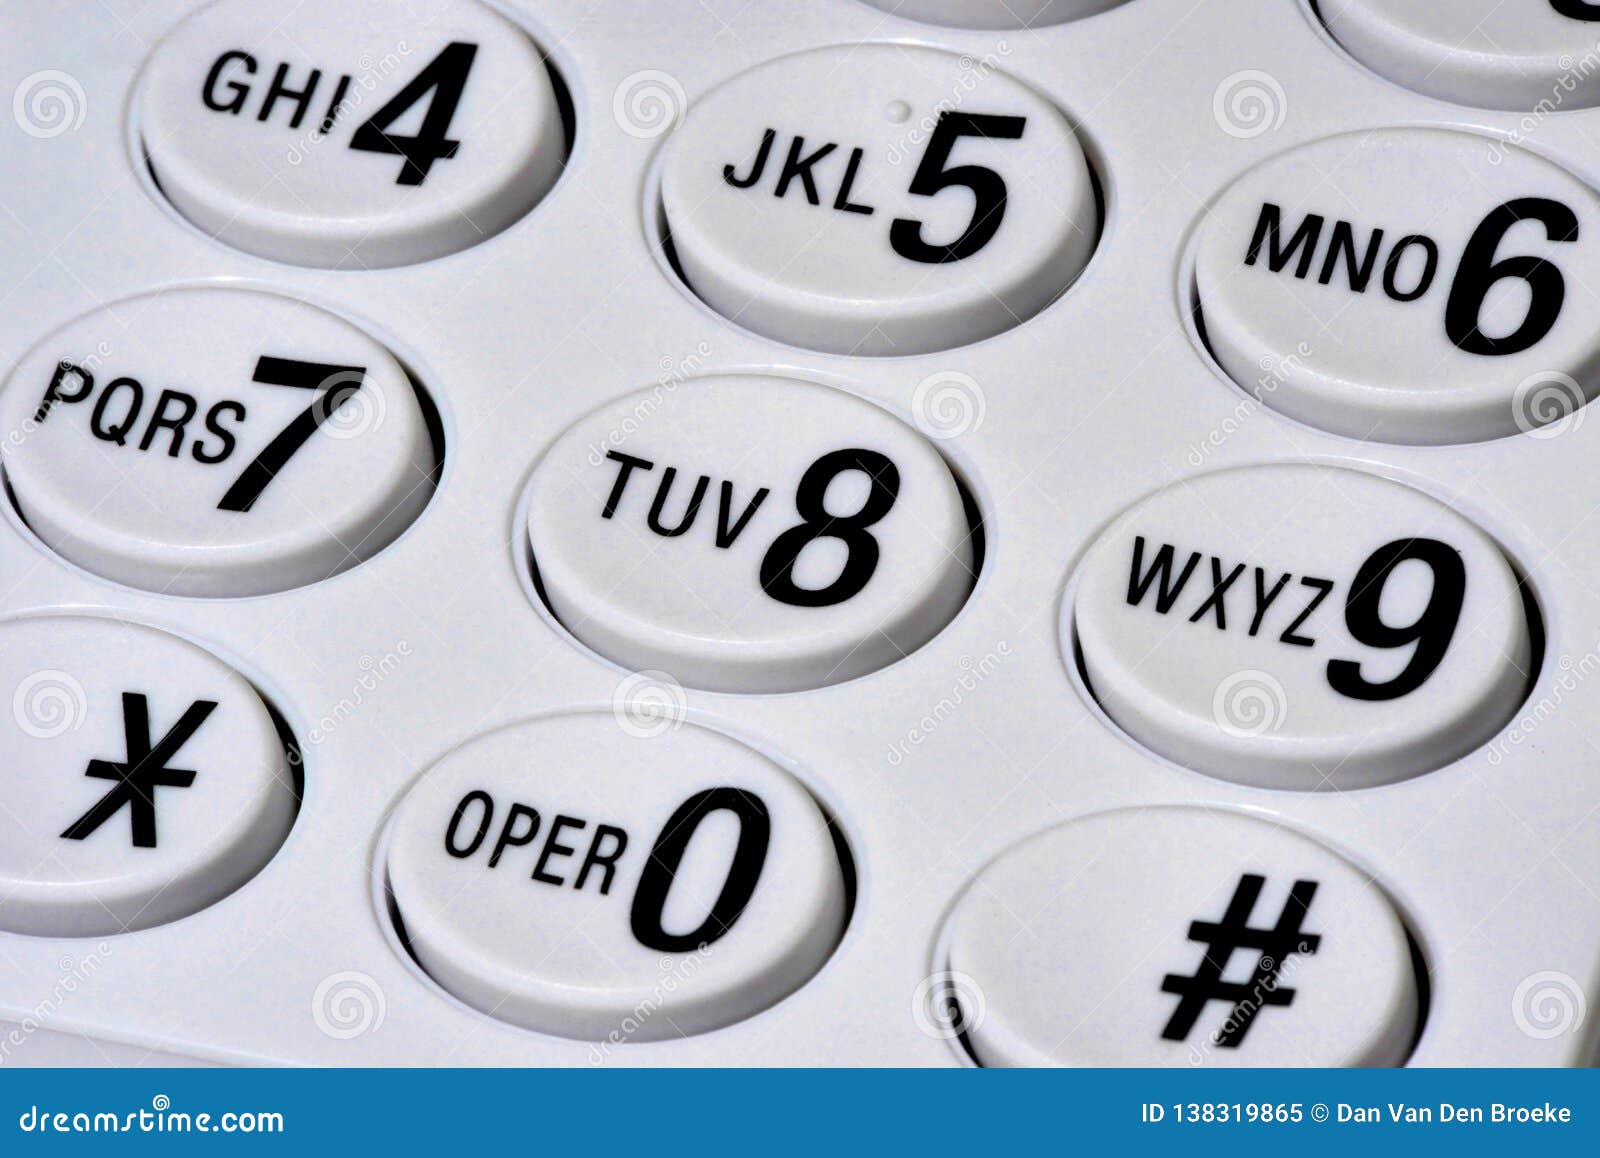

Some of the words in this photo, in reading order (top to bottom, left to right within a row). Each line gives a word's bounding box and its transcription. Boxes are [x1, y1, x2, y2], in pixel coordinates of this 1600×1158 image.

[202, 50, 351, 135] GHI
[348, 41, 479, 187] 4
[723, 128, 875, 216] JKL
[889, 110, 1027, 265] 5
[1243, 202, 1439, 303] MNO
[1444, 197, 1579, 357] 6
[34, 361, 246, 465] PQRS
[216, 355, 367, 513] 7
[601, 449, 770, 550] TUV
[759, 448, 901, 608] 8
[1126, 535, 1335, 648] WXYZ
[1326, 537, 1467, 702] 9
[444, 790, 629, 896] OPER
[629, 786, 771, 954] 0
